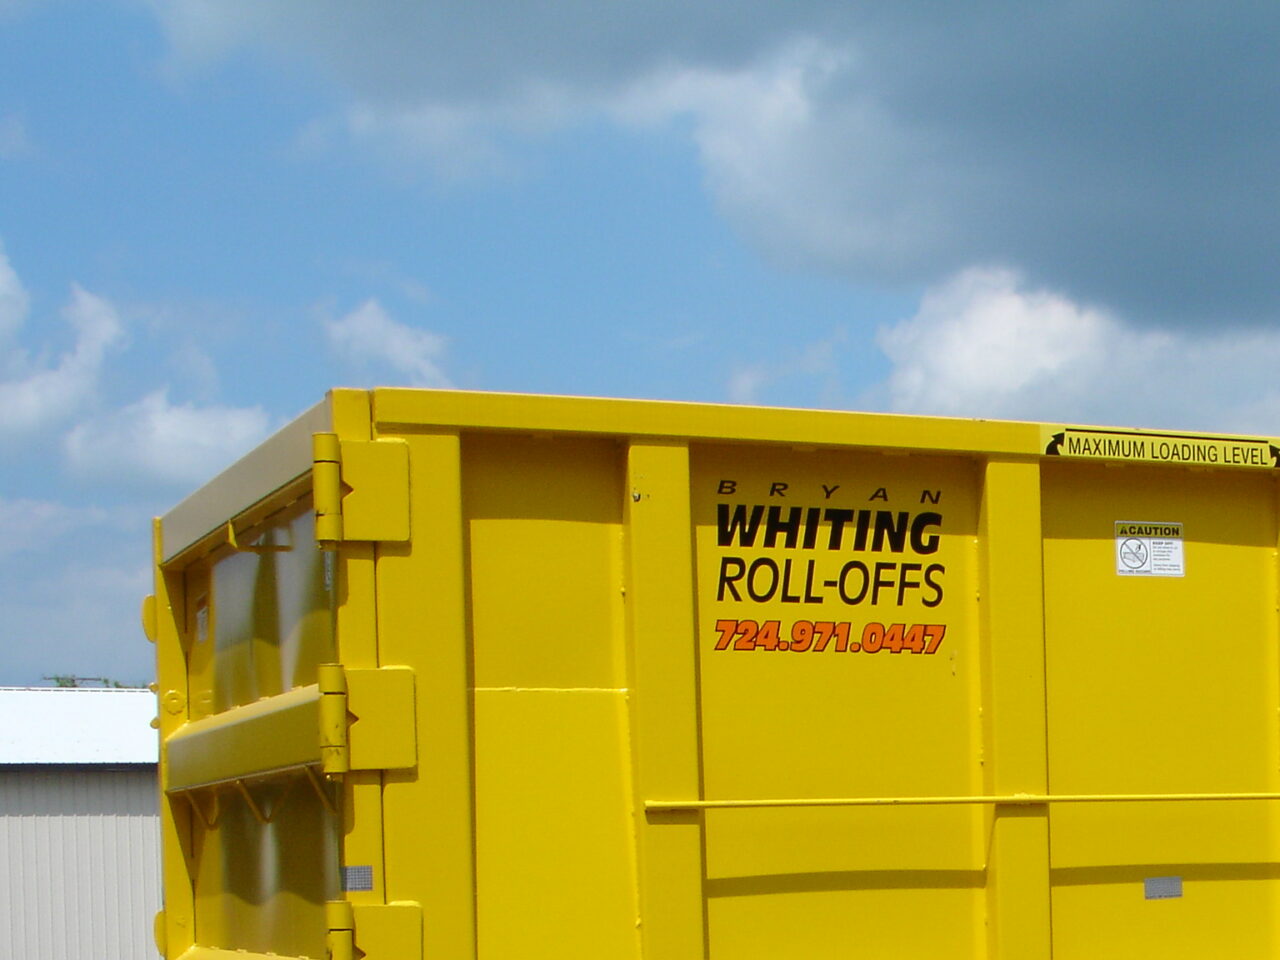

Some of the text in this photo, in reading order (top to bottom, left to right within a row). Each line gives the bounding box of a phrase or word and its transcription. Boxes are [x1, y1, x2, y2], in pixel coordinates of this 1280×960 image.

[1067, 437, 1269, 466] MAXIMUM LOADING LEVEL
[716, 503, 943, 554] WHITING
[1128, 525, 1180, 536] CAUTION
[716, 556, 945, 607] ROLL-OFFS
[714, 619, 946, 654] 724.971.0447
